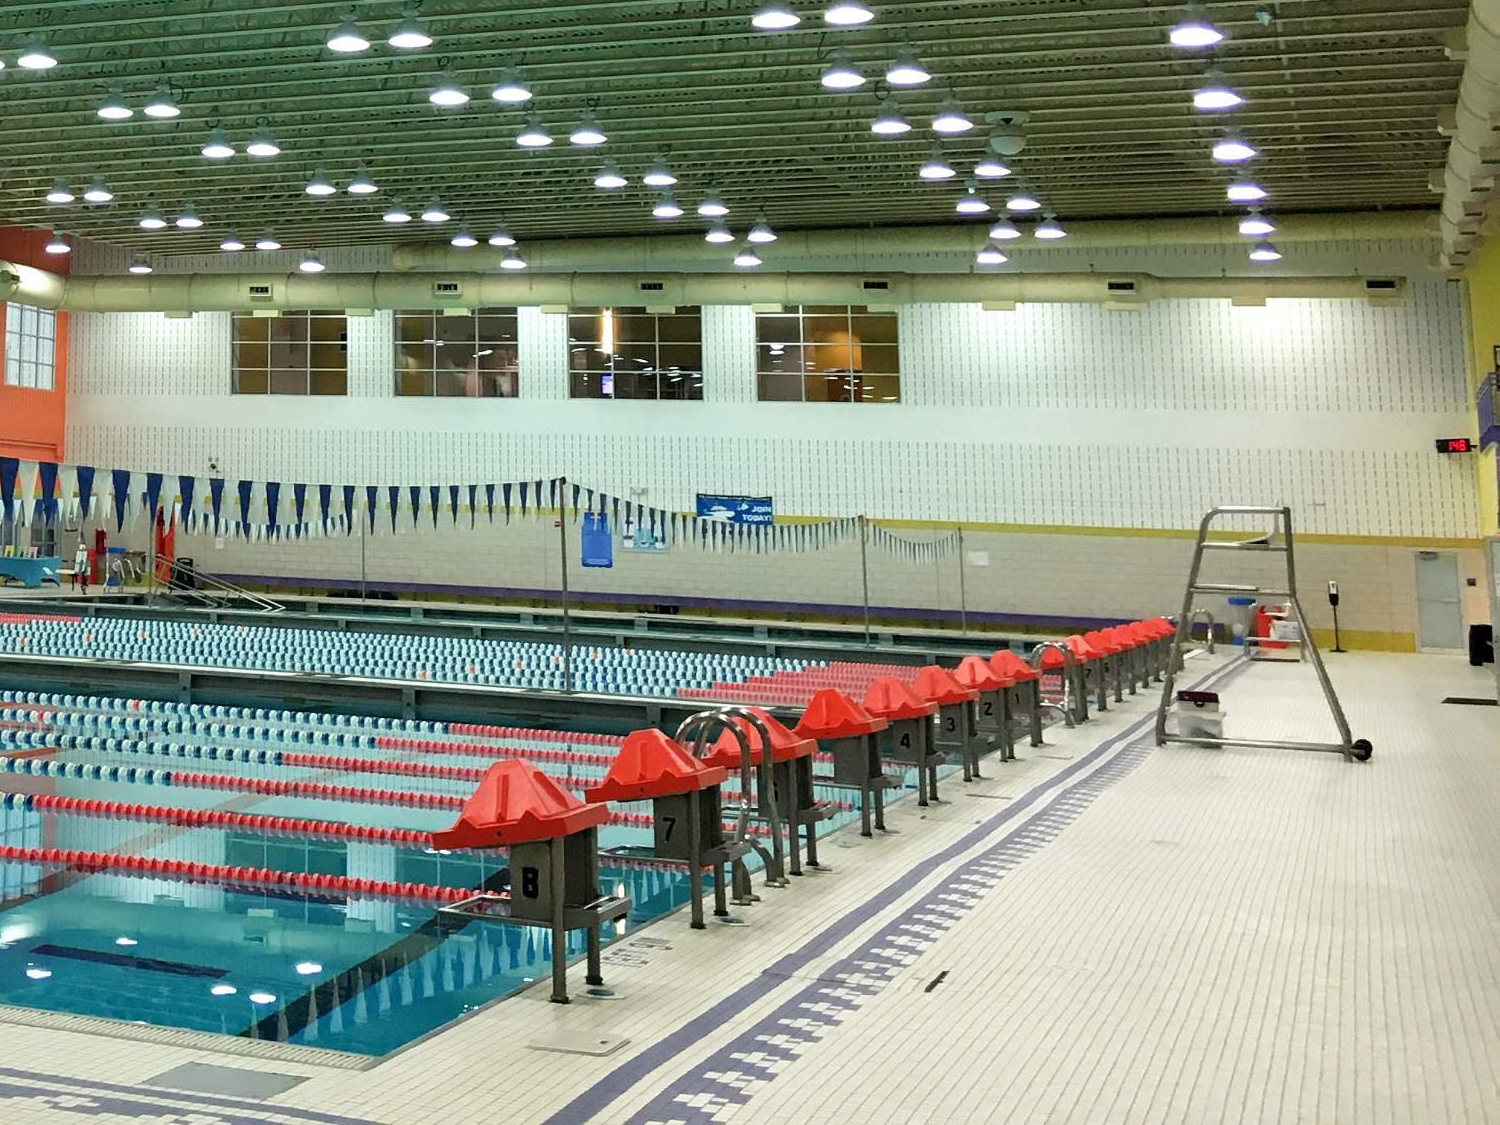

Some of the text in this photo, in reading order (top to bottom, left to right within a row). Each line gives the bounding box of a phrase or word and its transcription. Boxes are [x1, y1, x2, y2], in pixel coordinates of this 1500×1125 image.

[742, 513, 773, 522] TODAY!
[1085, 668, 1092, 679] 7
[1013, 693, 1021, 705] 1
[984, 702, 993, 716] 2
[946, 717, 956, 732] 3
[900, 732, 911, 749] 4
[662, 816, 676, 843] 7
[521, 866, 540, 899] 8
